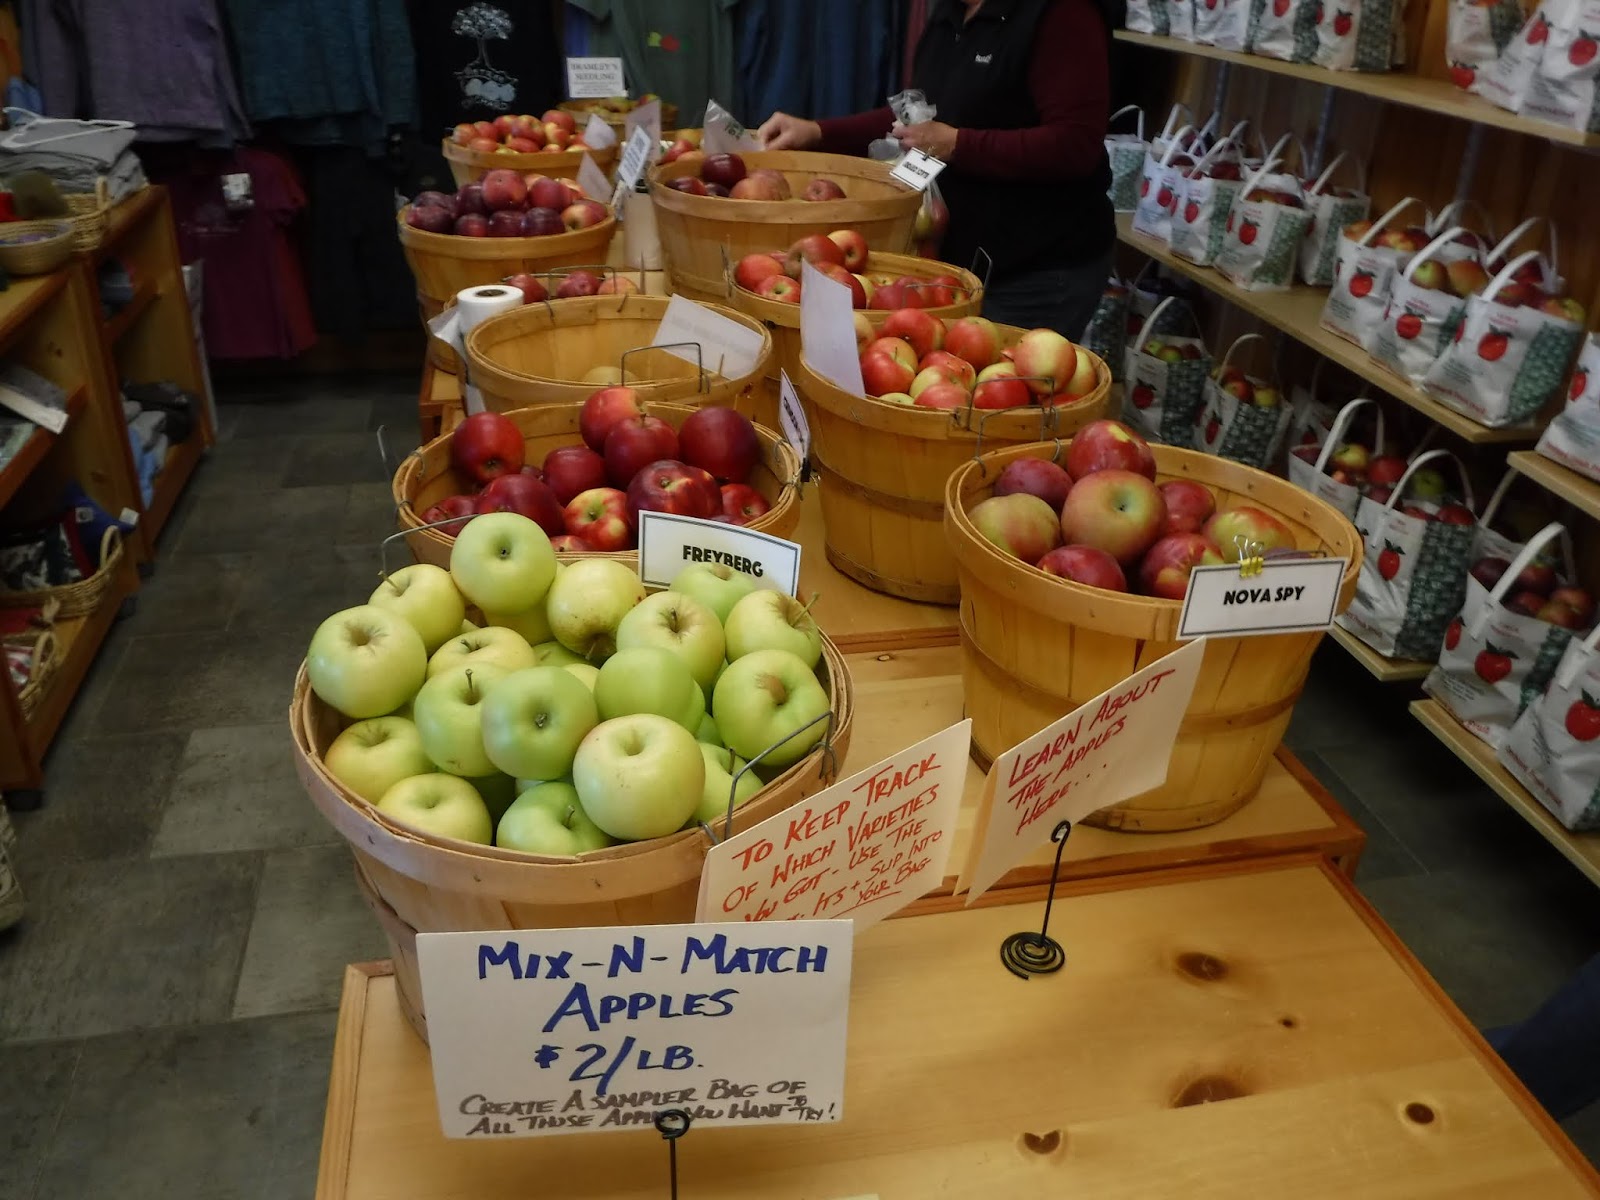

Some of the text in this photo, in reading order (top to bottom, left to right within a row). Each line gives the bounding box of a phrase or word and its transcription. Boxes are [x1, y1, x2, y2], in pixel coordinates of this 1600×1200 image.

[682, 544, 764, 578] FREYBERG
[1222, 585, 1305, 606] NOVA SPY
[1008, 668, 1176, 788] LEARN ABOUT
[1007, 715, 1128, 810] THE APPLES
[731, 752, 942, 872] TO KEEP TRACK
[722, 783, 940, 913] OF WHICH VARIETIES
[848, 844, 883, 871] USE
[886, 819, 927, 848] THE
[866, 853, 903, 882] SLIP
[907, 830, 943, 860] INTO
[894, 857, 932, 886] BAG
[542, 982, 740, 1033] APPLES
[459, 1078, 806, 1115] CREATE A SAMPLER BAG OF
[466, 1116, 515, 1136] ALL
[517, 1114, 595, 1130] THOSE
[727, 1100, 791, 1119] WANT
